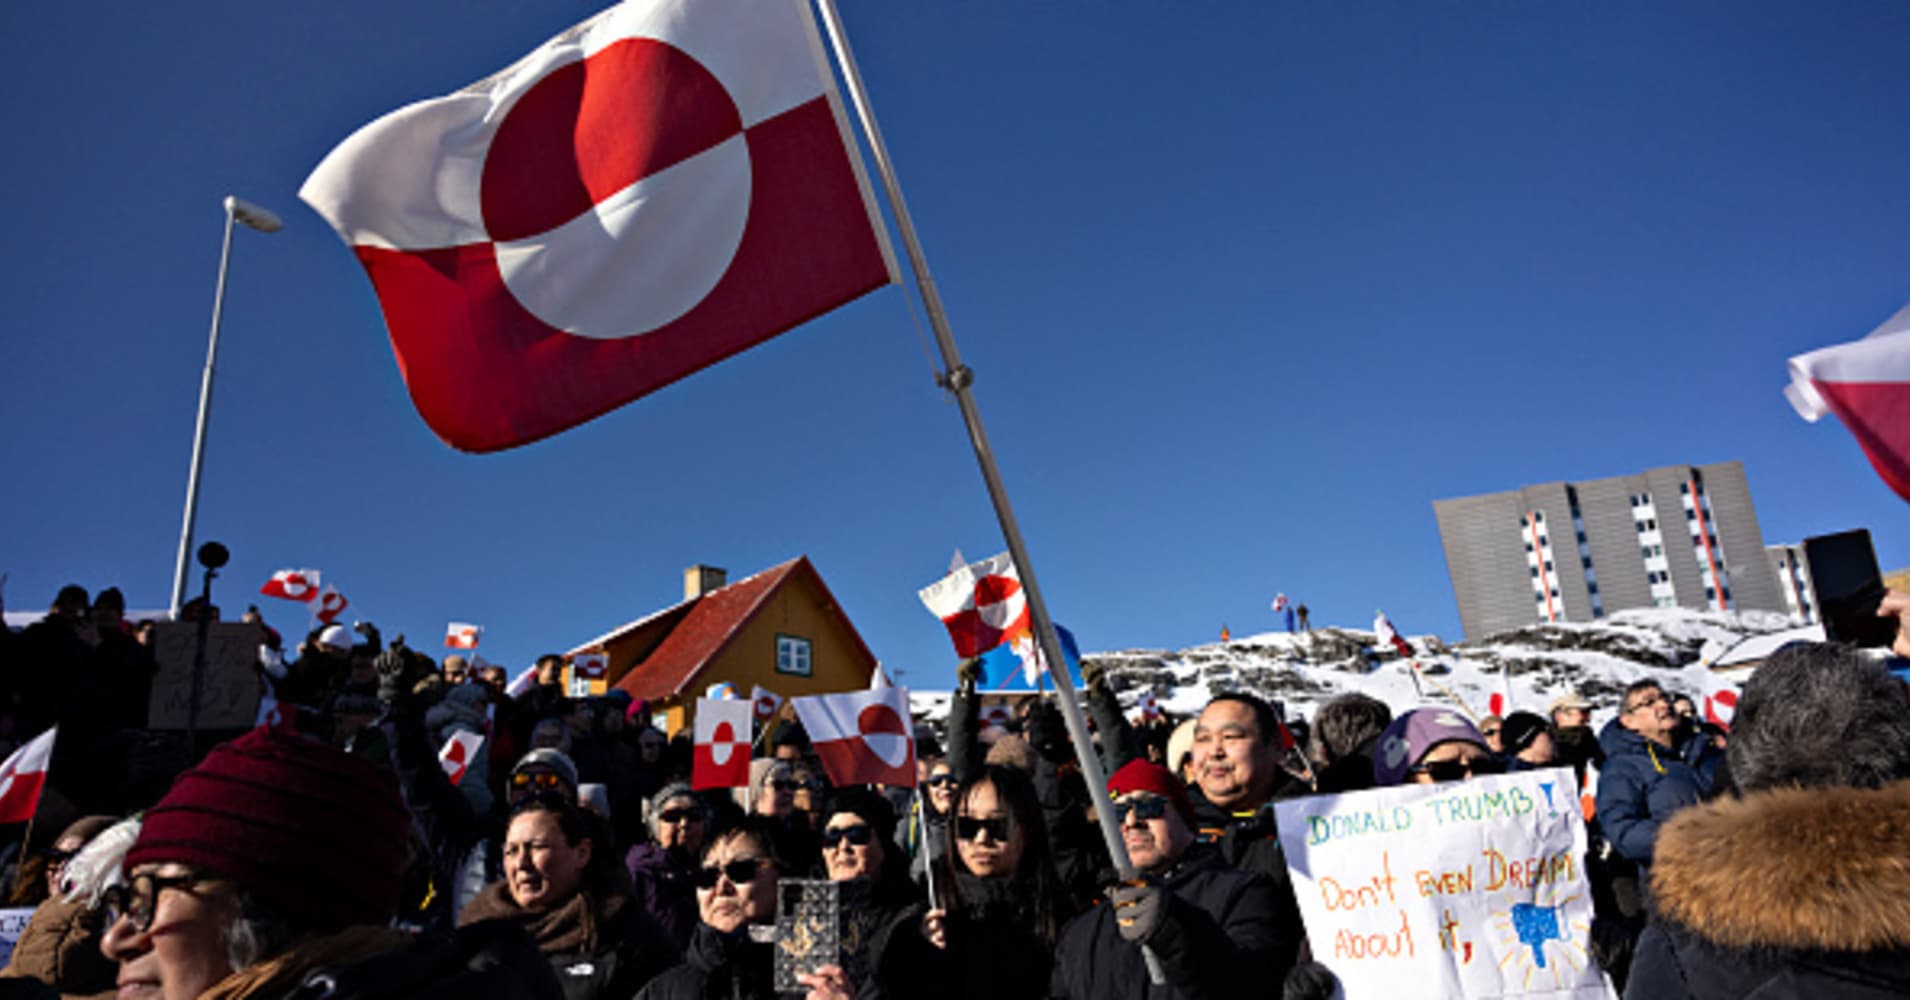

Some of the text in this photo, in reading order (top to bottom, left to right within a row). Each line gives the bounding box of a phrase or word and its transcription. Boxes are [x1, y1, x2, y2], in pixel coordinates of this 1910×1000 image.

[1307, 810, 1411, 845] DONALD
[1320, 851, 1397, 911] Don't
[1416, 866, 1472, 897] EVEN
[1439, 910, 1472, 963] it,
